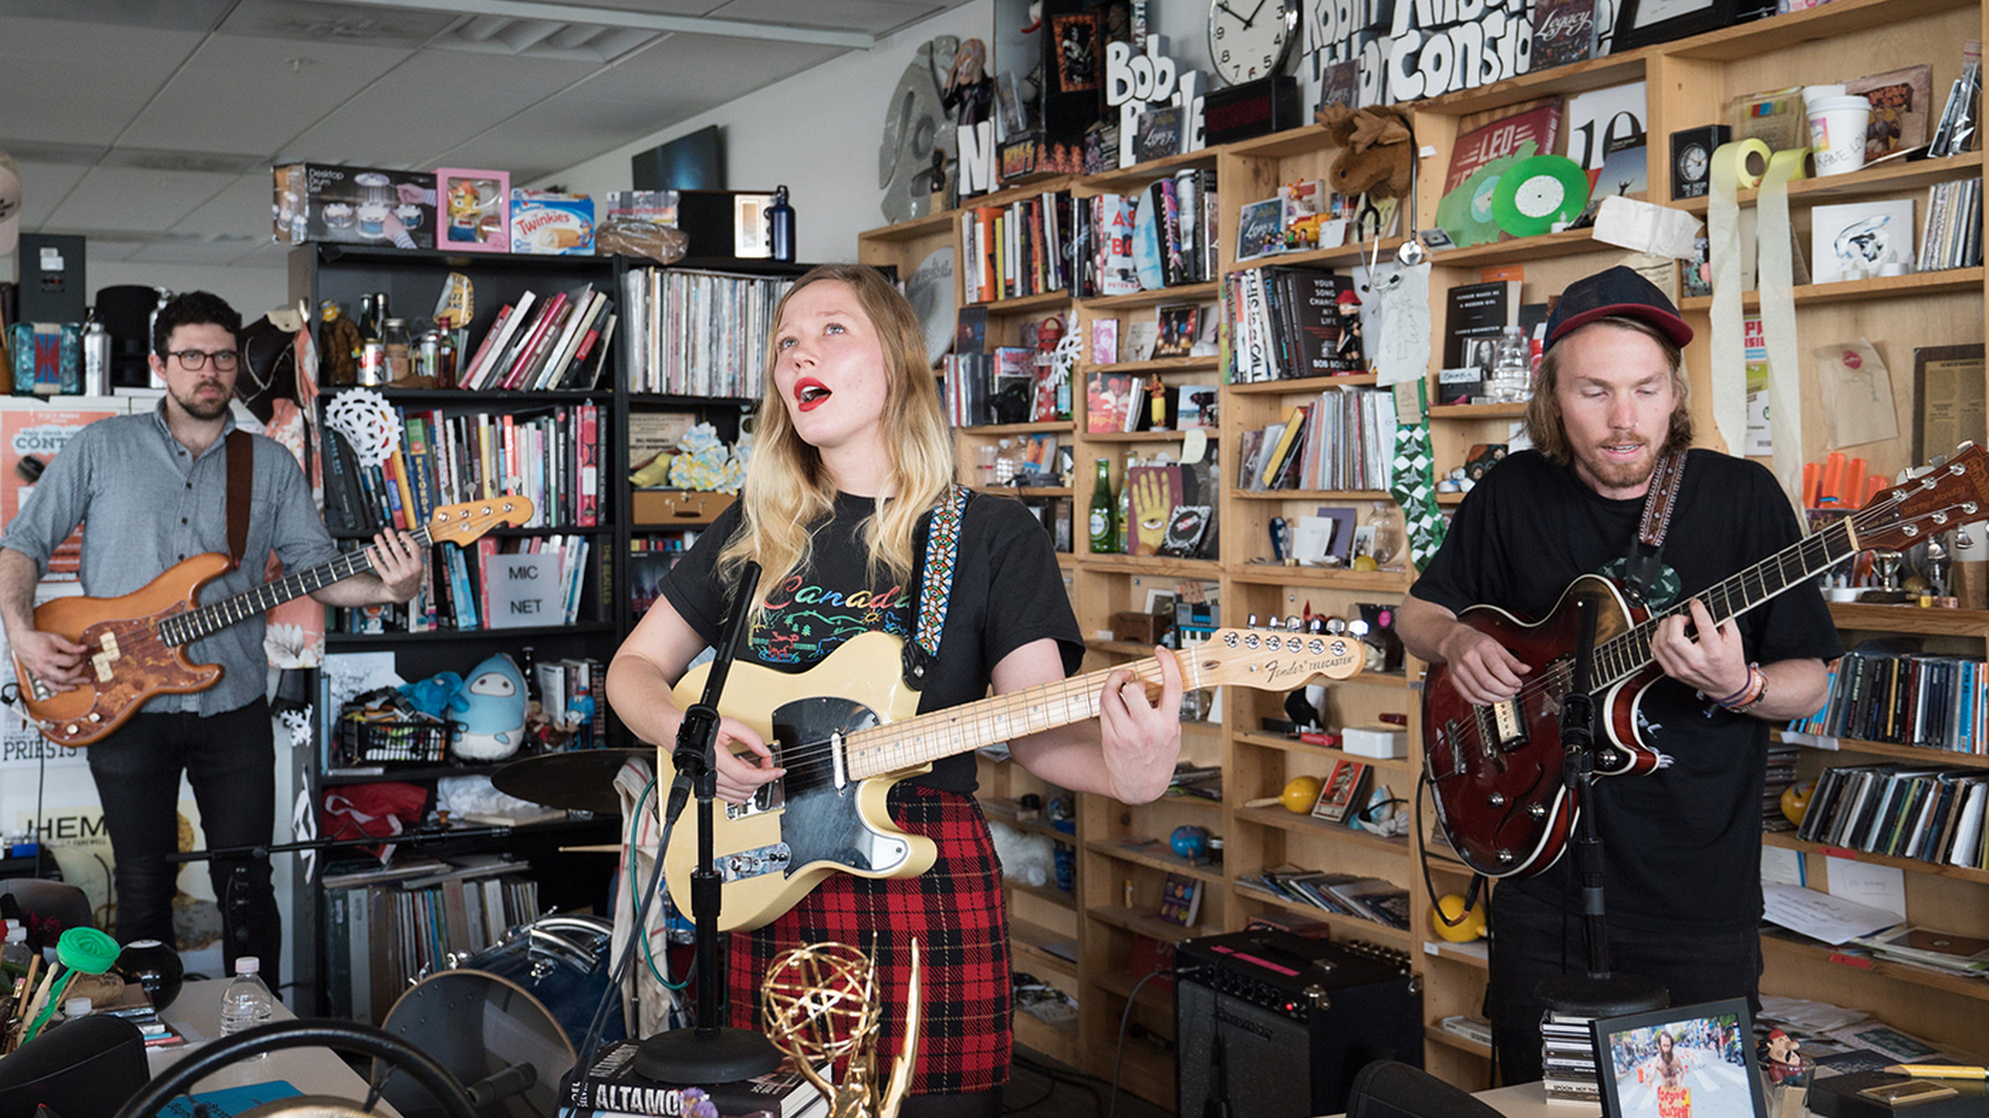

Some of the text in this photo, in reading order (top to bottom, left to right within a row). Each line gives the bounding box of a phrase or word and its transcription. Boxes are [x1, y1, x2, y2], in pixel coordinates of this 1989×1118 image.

[1276, 5, 1285, 20] 3
[1534, 9, 1593, 41] Legacy
[1216, 26, 1225, 40] 9
[1273, 33, 1282, 45] 4
[1221, 49, 1230, 63] 8
[1263, 54, 1272, 69] 5
[1106, 33, 1175, 106] Bob
[1233, 64, 1241, 78] 7
[1573, 111, 1643, 171] 10
[308, 168, 345, 181] Desktop
[308, 177, 332, 187] Drum
[515, 210, 570, 236] Twinkies
[1314, 288, 1336, 297] SONG
[508, 565, 539, 580] MIC
[764, 575, 911, 610] Canada
[510, 599, 543, 614] NET
[1264, 655, 1355, 684] Fender TELECASTER
